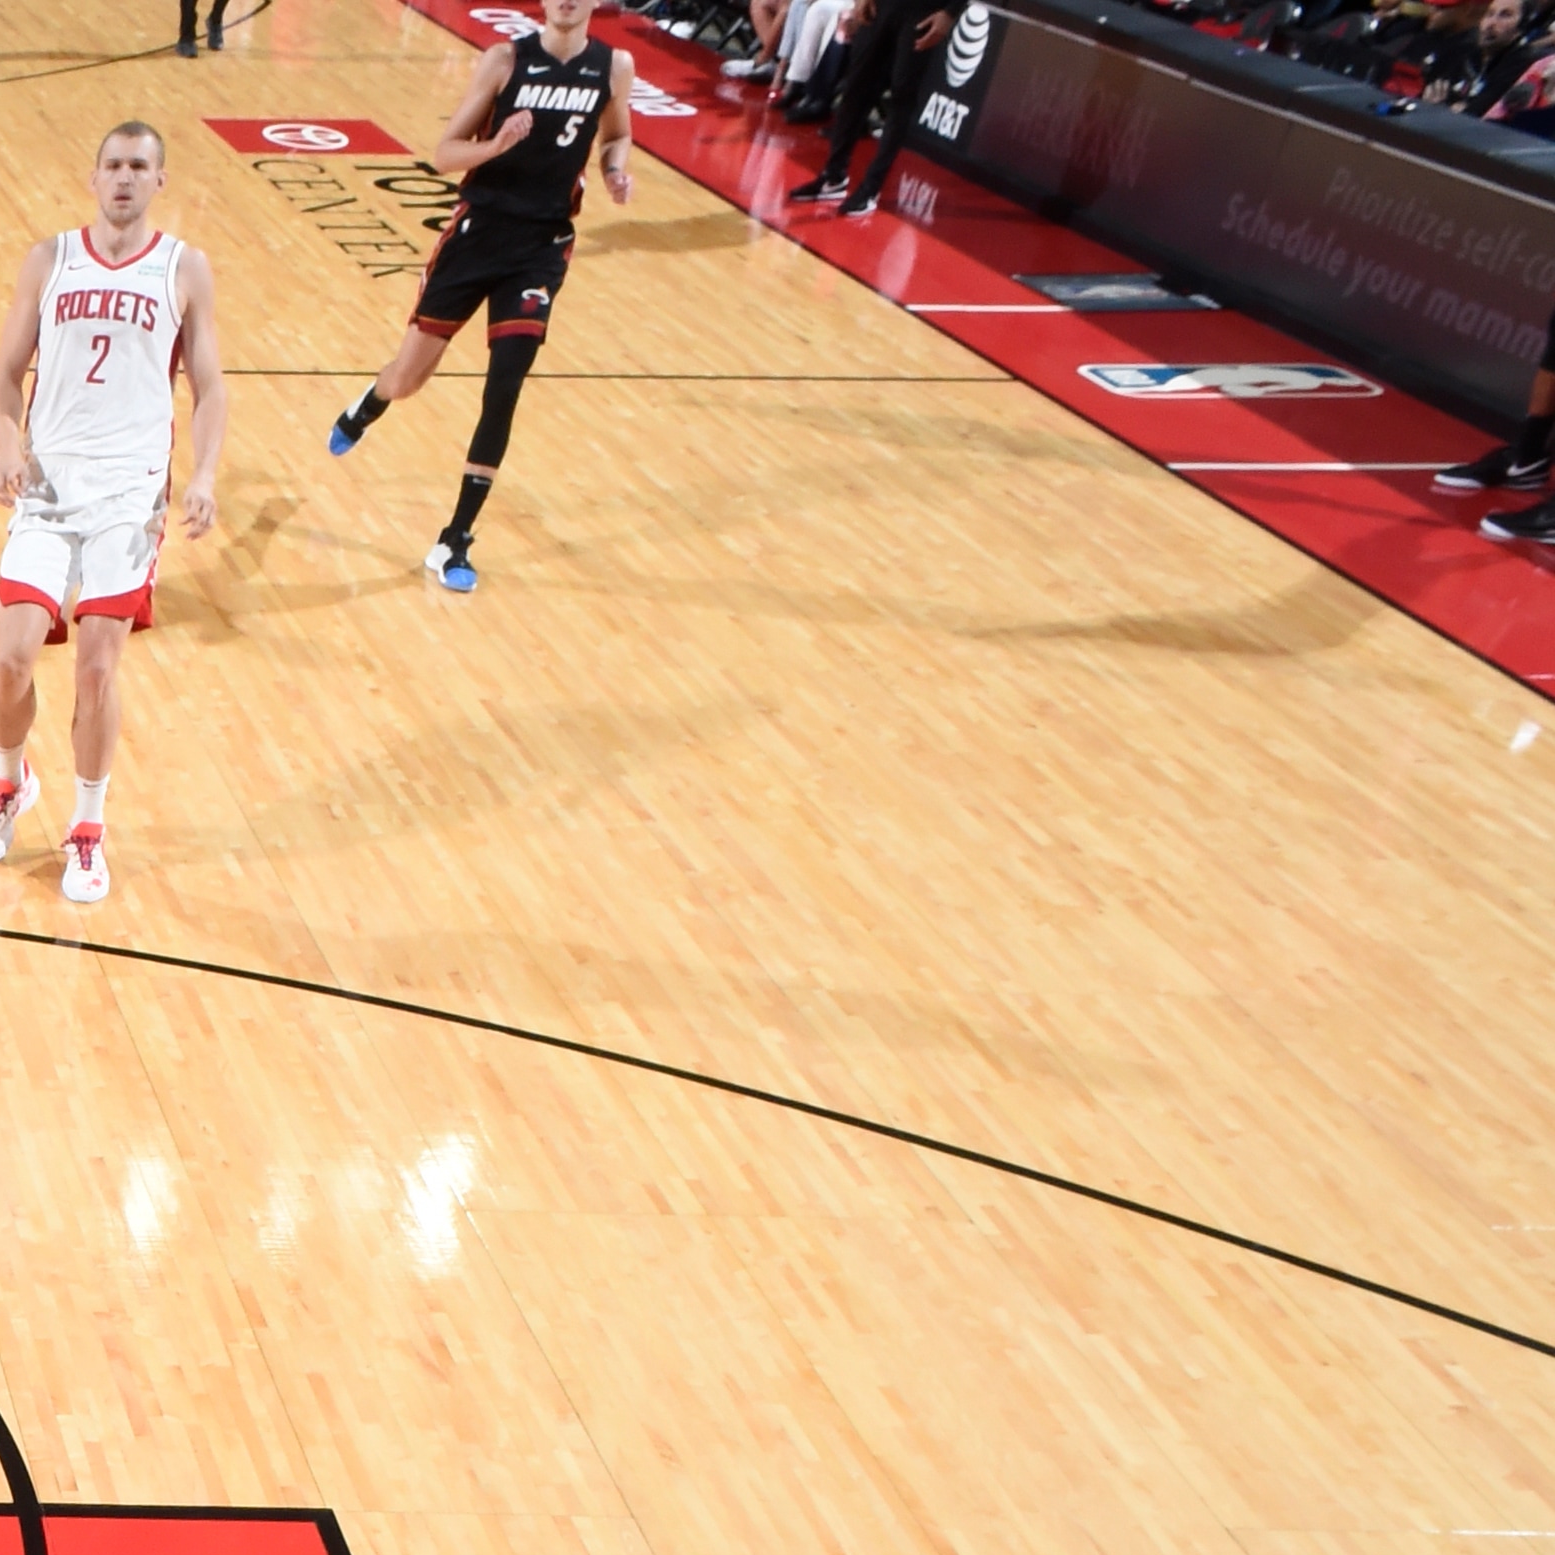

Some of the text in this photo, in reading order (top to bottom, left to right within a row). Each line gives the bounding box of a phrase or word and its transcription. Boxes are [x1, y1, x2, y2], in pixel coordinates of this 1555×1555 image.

[513, 84, 600, 113] MIAMI
[918, 91, 970, 140] AT&T
[556, 115, 585, 147] 5
[1323, 166, 1454, 252] Prioritize
[1220, 192, 1348, 277] Schedule
[1343, 254, 1424, 299] your
[55, 288, 159, 332] ROCKETS
[86, 334, 111, 384] 2
